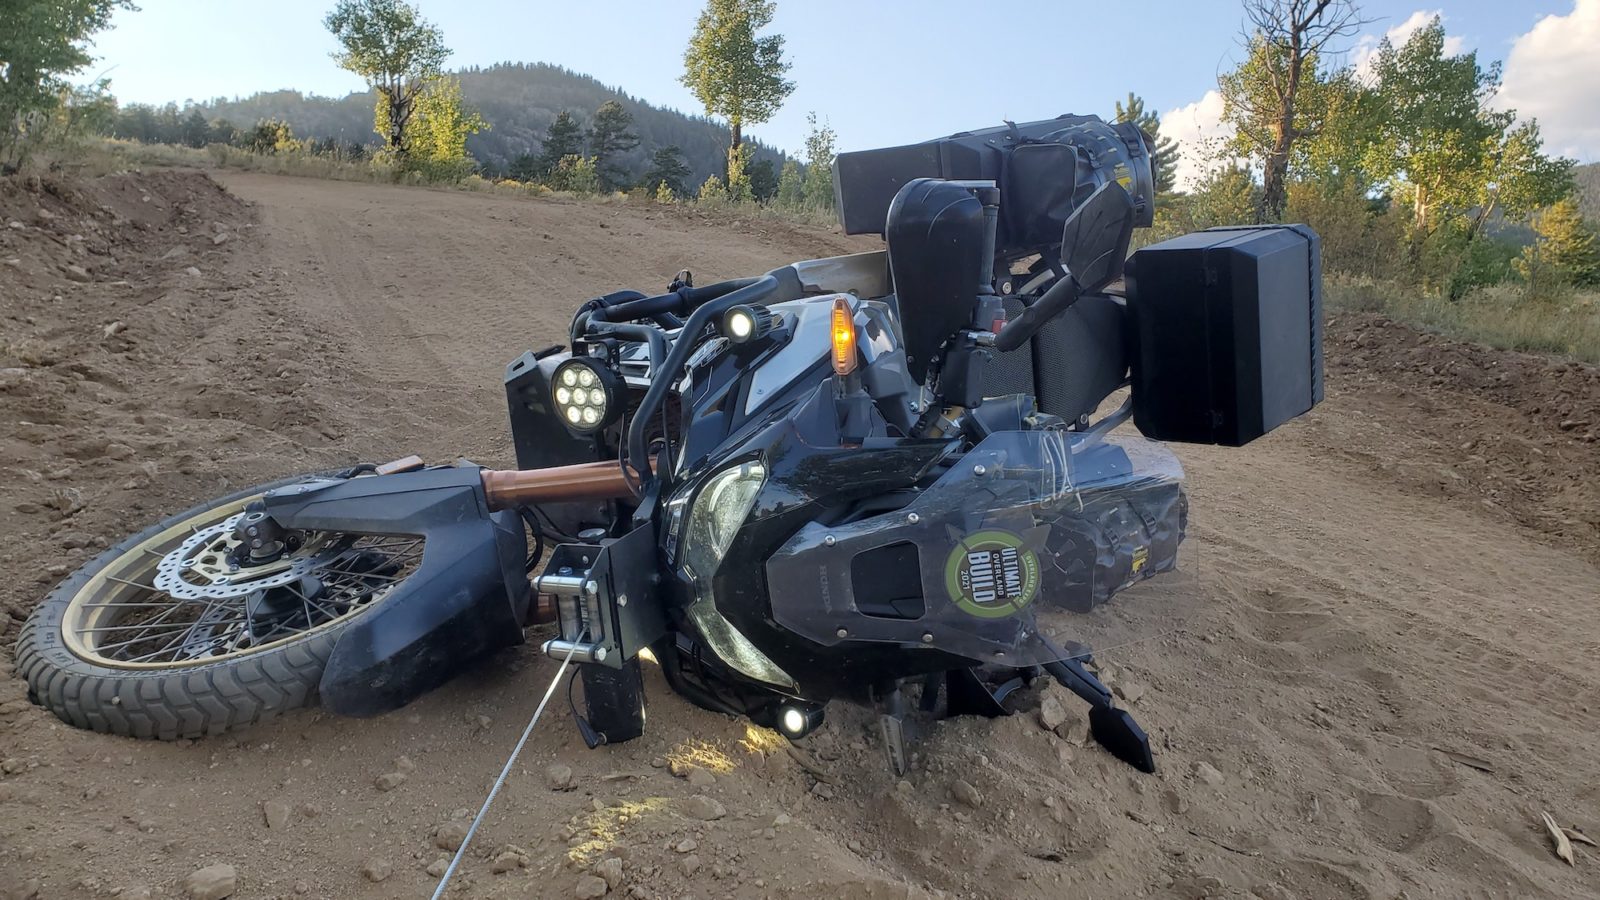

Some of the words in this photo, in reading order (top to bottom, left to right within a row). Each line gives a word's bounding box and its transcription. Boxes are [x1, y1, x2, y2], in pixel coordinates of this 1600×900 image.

[818, 565, 832, 614] HONDA
[960, 570, 969, 590] 2021
[967, 550, 996, 603] BUILD
[992, 553, 1003, 596] OVERLAND
[1001, 547, 1022, 598] ULTIMATE
[1025, 555, 1036, 588] OVERLAND
[1018, 588, 1031, 604] EXPO
